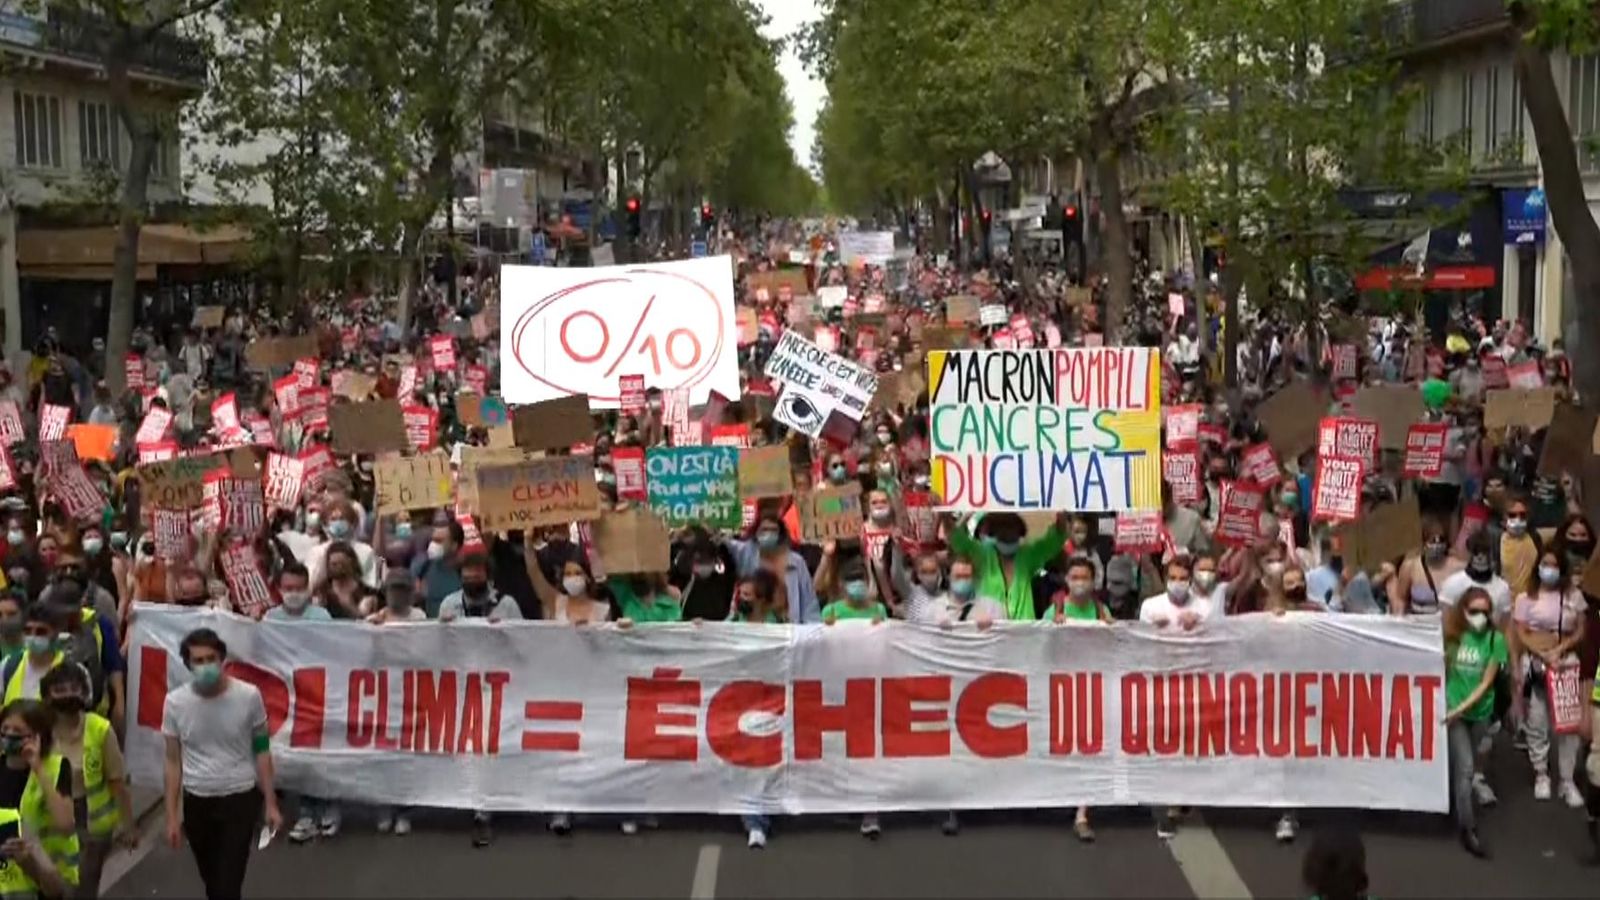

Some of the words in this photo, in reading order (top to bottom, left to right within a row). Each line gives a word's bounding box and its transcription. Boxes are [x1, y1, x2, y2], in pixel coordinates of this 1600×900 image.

[560, 294, 702, 378] 0/10
[932, 350, 1055, 404] MACRON
[932, 404, 1121, 454] CANCRES
[647, 453, 678, 476] ON
[680, 452, 713, 475] EST
[936, 455, 988, 507] DU
[989, 450, 1147, 509] CLIMAT
[1322, 459, 1361, 472] VOUS
[512, 480, 579, 502] CLEAN
[345, 667, 511, 755] CLIMAT
[521, 700, 584, 752] =
[624, 666, 1029, 769] ÉCHEC
[1049, 671, 1104, 756] DU
[1120, 670, 1442, 761] QUINQUENNAT
